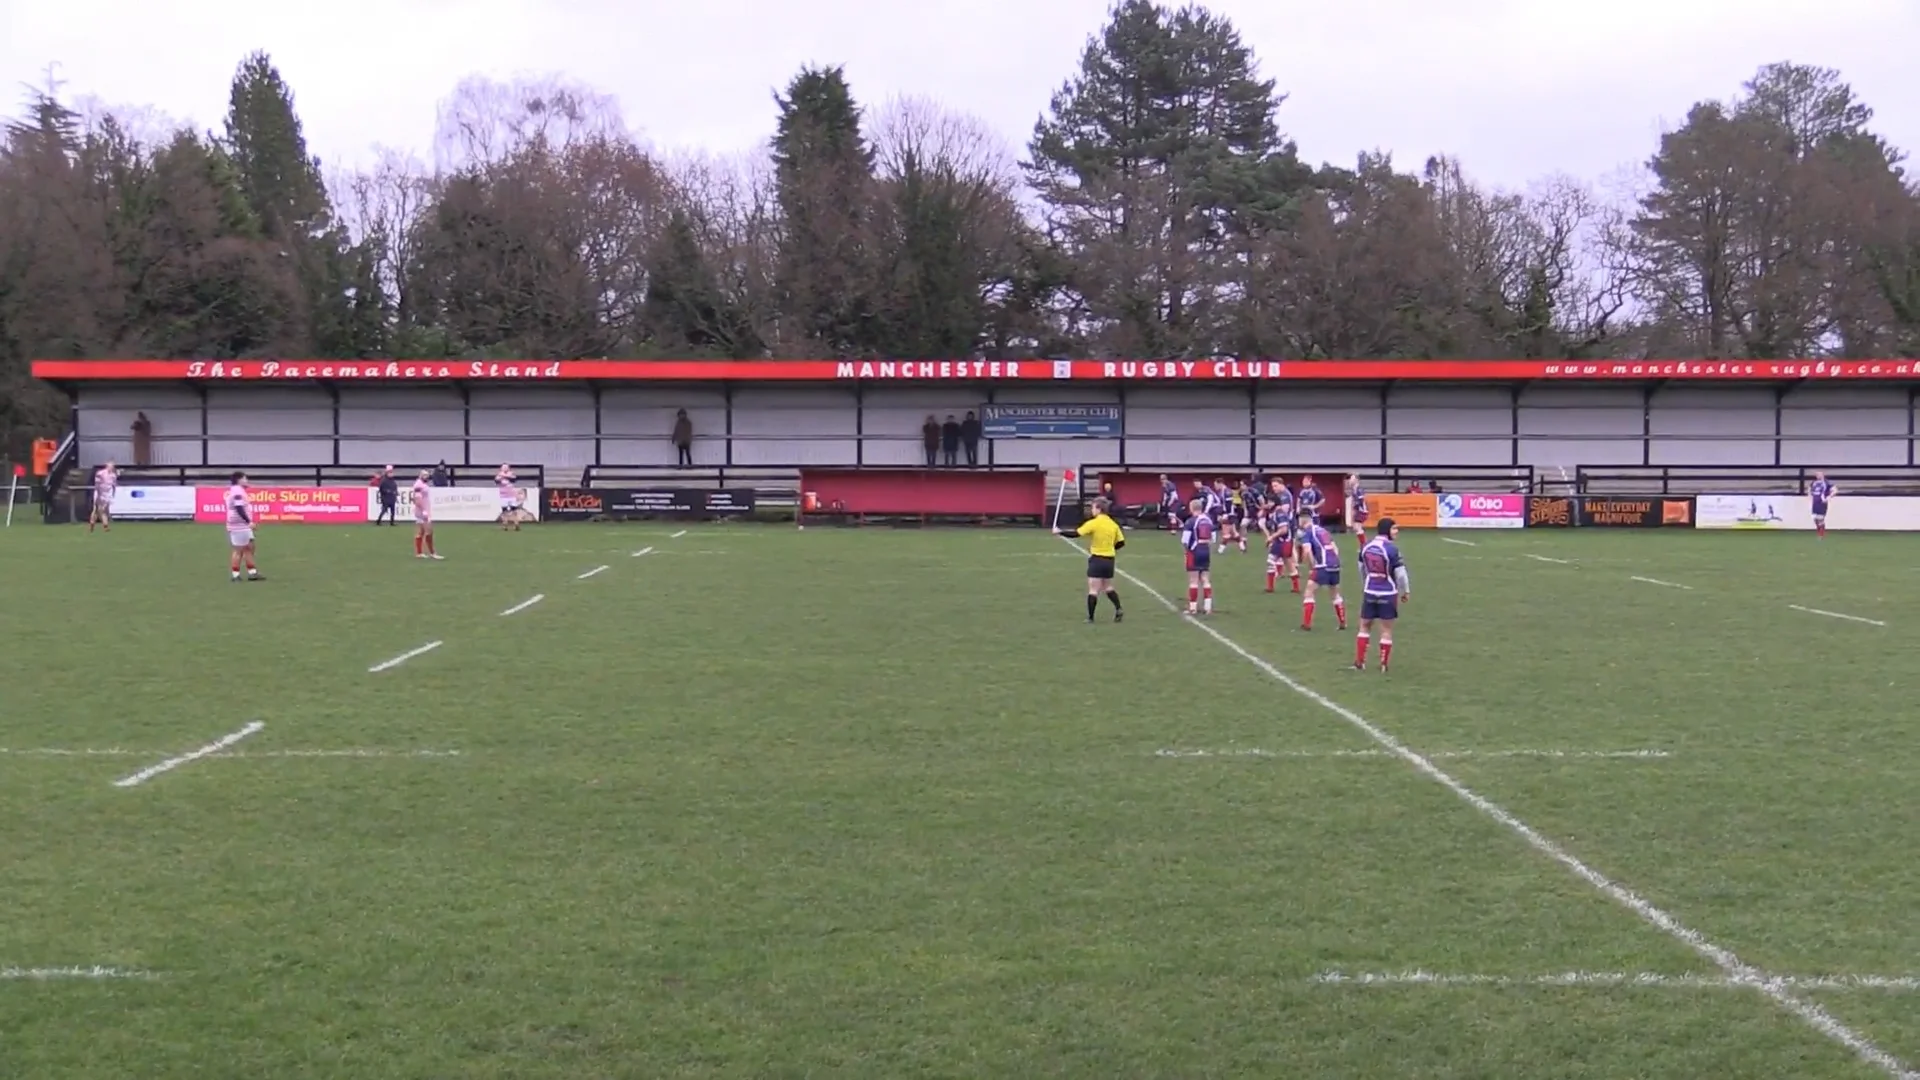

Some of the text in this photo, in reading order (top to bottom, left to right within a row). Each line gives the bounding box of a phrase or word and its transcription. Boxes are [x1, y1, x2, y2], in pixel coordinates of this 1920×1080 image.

[186, 361, 560, 378] The Pacemakers Stand
[836, 361, 1282, 378] MANCHESTER RUGBY CLUB
[985, 407, 1119, 420] MANCHESTER RUGBY CLUB
[280, 490, 309, 504] Skip
[312, 490, 341, 503] Hire
[549, 489, 603, 509] Artisan
[1584, 501, 1651, 512] MAKE EVERYDAY
